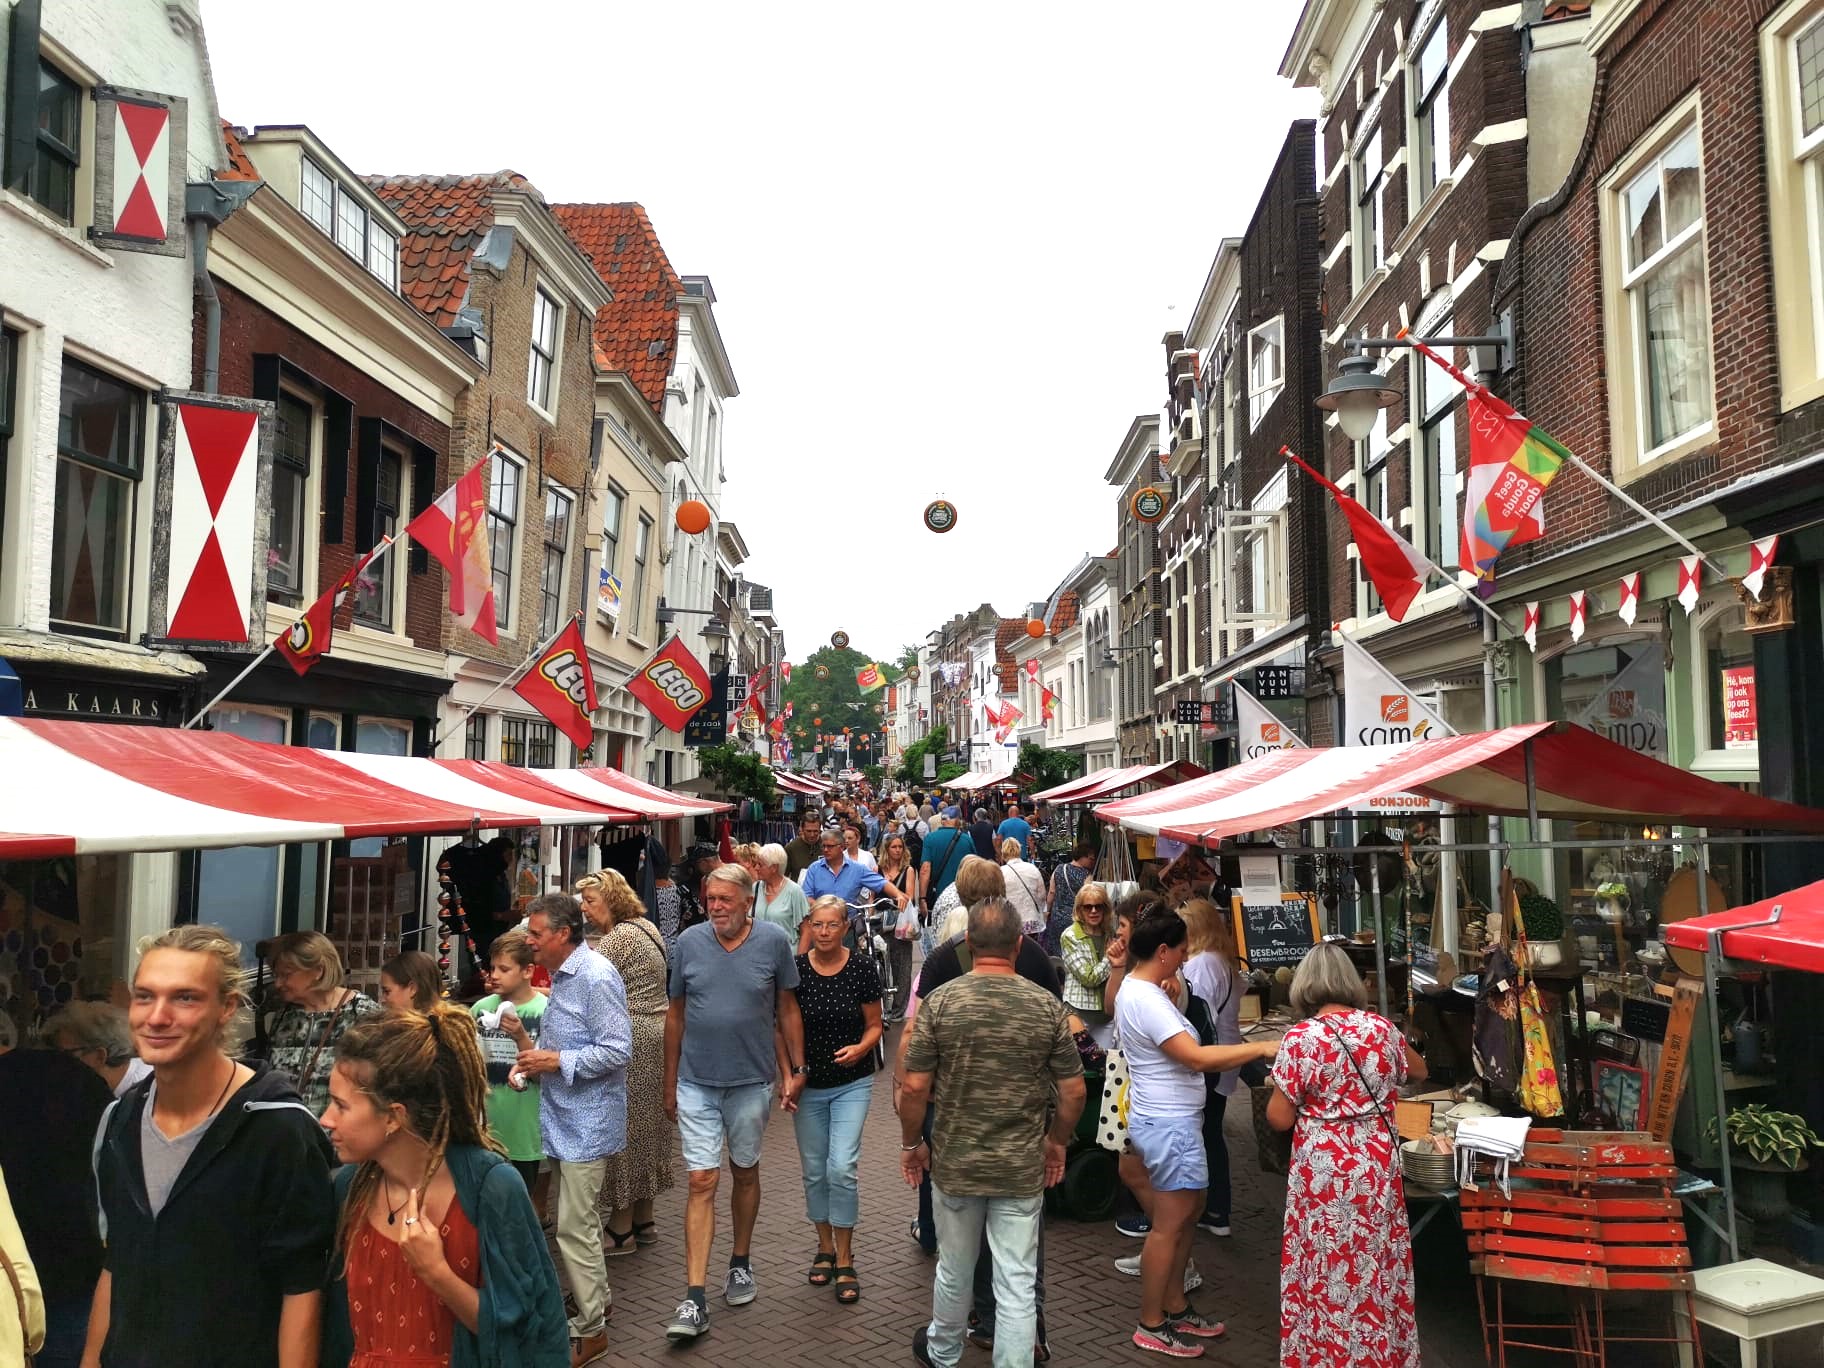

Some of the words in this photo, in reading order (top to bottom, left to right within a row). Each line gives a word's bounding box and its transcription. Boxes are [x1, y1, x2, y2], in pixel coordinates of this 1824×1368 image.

[1258, 670, 1287, 678] VAN
[647, 660, 703, 710] LEGO
[1727, 676, 1738, 687] Hé,
[1739, 675, 1754, 685] kom
[1734, 686, 1747, 696] ook
[67, 692, 158, 717] KAARS
[1727, 701, 1736, 709] op
[1737, 699, 1750, 707] ons
[1727, 708, 1750, 719] feest?
[1369, 796, 1430, 807] BONJOUR
